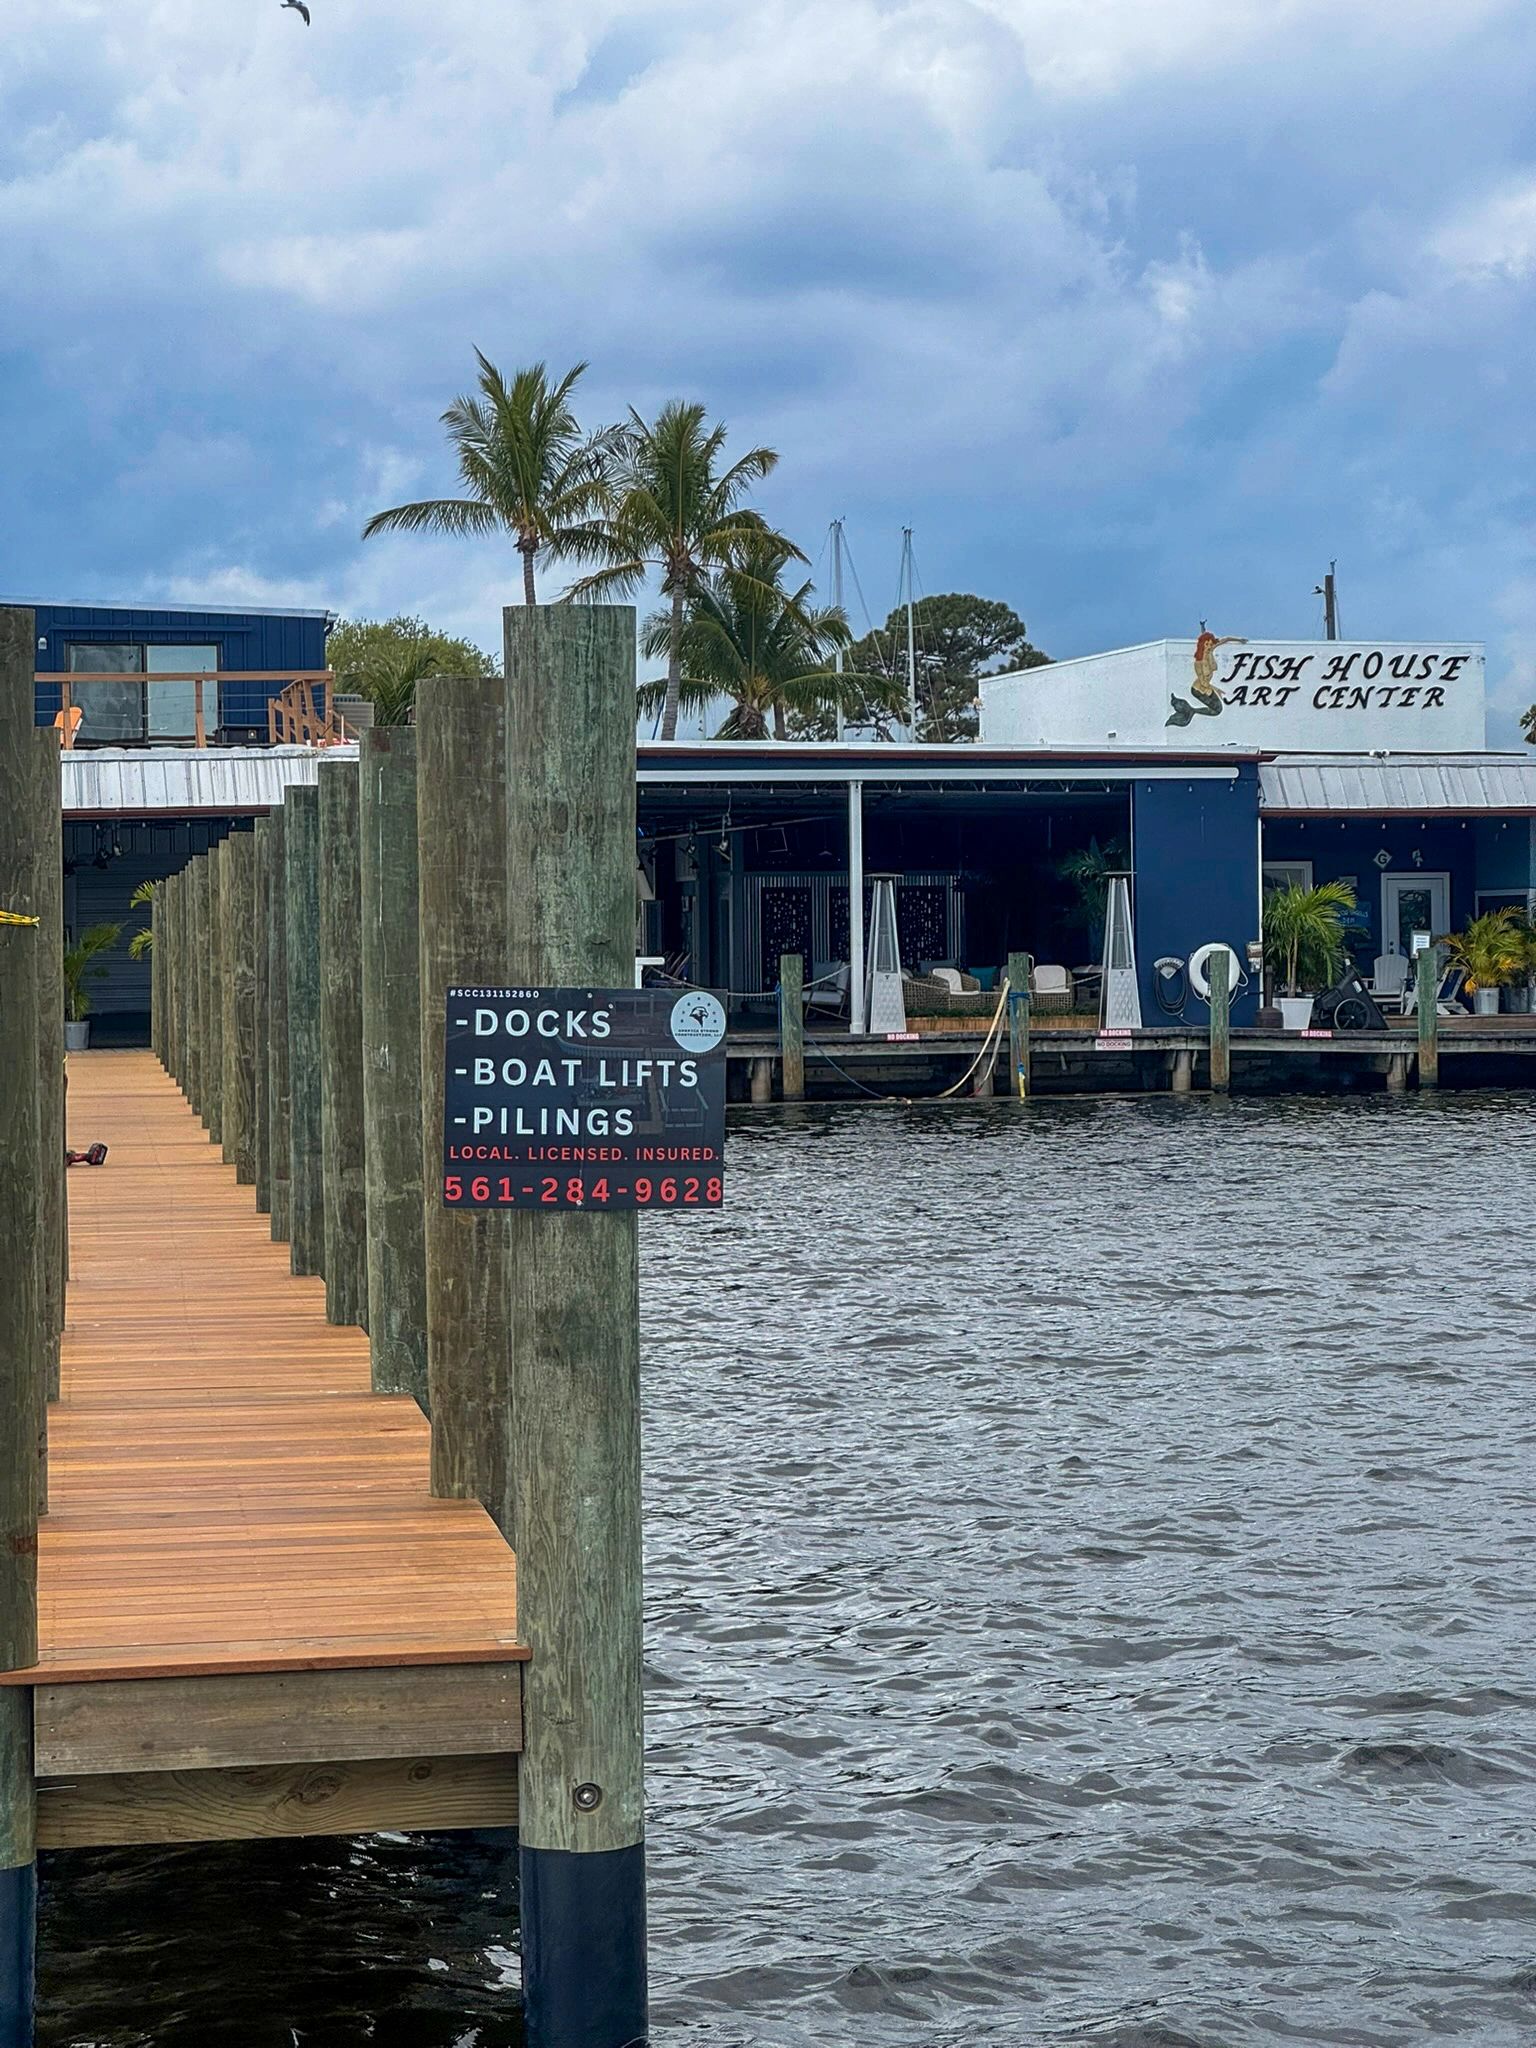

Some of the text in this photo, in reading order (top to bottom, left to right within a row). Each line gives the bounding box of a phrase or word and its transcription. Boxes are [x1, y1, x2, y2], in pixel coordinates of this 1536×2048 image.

[1220, 650, 1470, 683] FISH HOUSE
[1223, 685, 1447, 710] ART CENTER
[450, 989, 540, 998] #SCC131152860
[455, 1009, 611, 1038] -DOCKS
[454, 1058, 698, 1087] -BOAT LIFTS
[454, 1107, 633, 1136] -PILINGS
[450, 1146, 719, 1160] LOCAL. LICENSED. INSURED.
[445, 1176, 722, 1203] 561-284-9628
